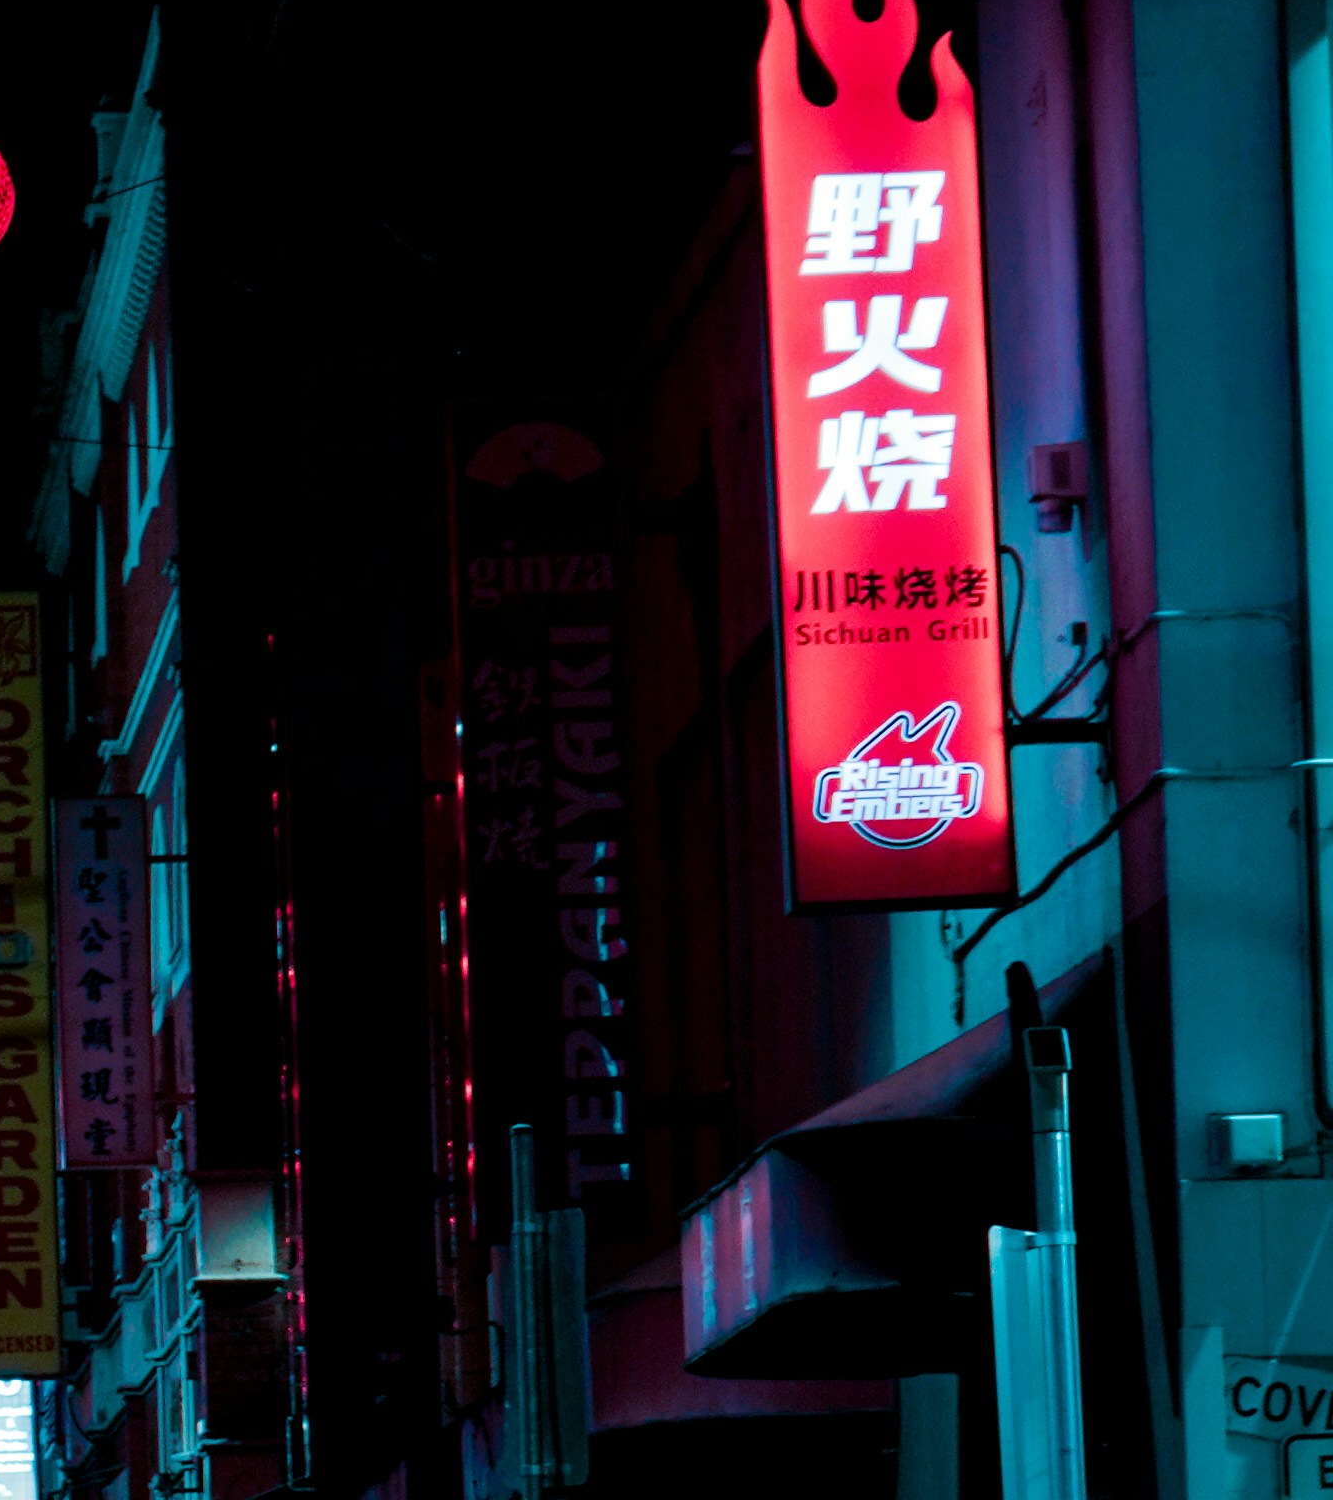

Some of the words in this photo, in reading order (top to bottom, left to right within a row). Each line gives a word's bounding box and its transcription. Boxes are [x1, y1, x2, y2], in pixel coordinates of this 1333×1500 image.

[799, 170, 956, 516] 野火烧
[467, 538, 613, 609] ginza
[794, 565, 988, 612] 川味烧烤
[796, 621, 910, 646] Sichuan
[928, 616, 989, 641] Grill
[839, 757, 959, 793] Rising
[830, 789, 965, 822] Embers
[546, 623, 633, 1199] TEPPANYAKI
[1233, 1376, 1333, 1430] COV
